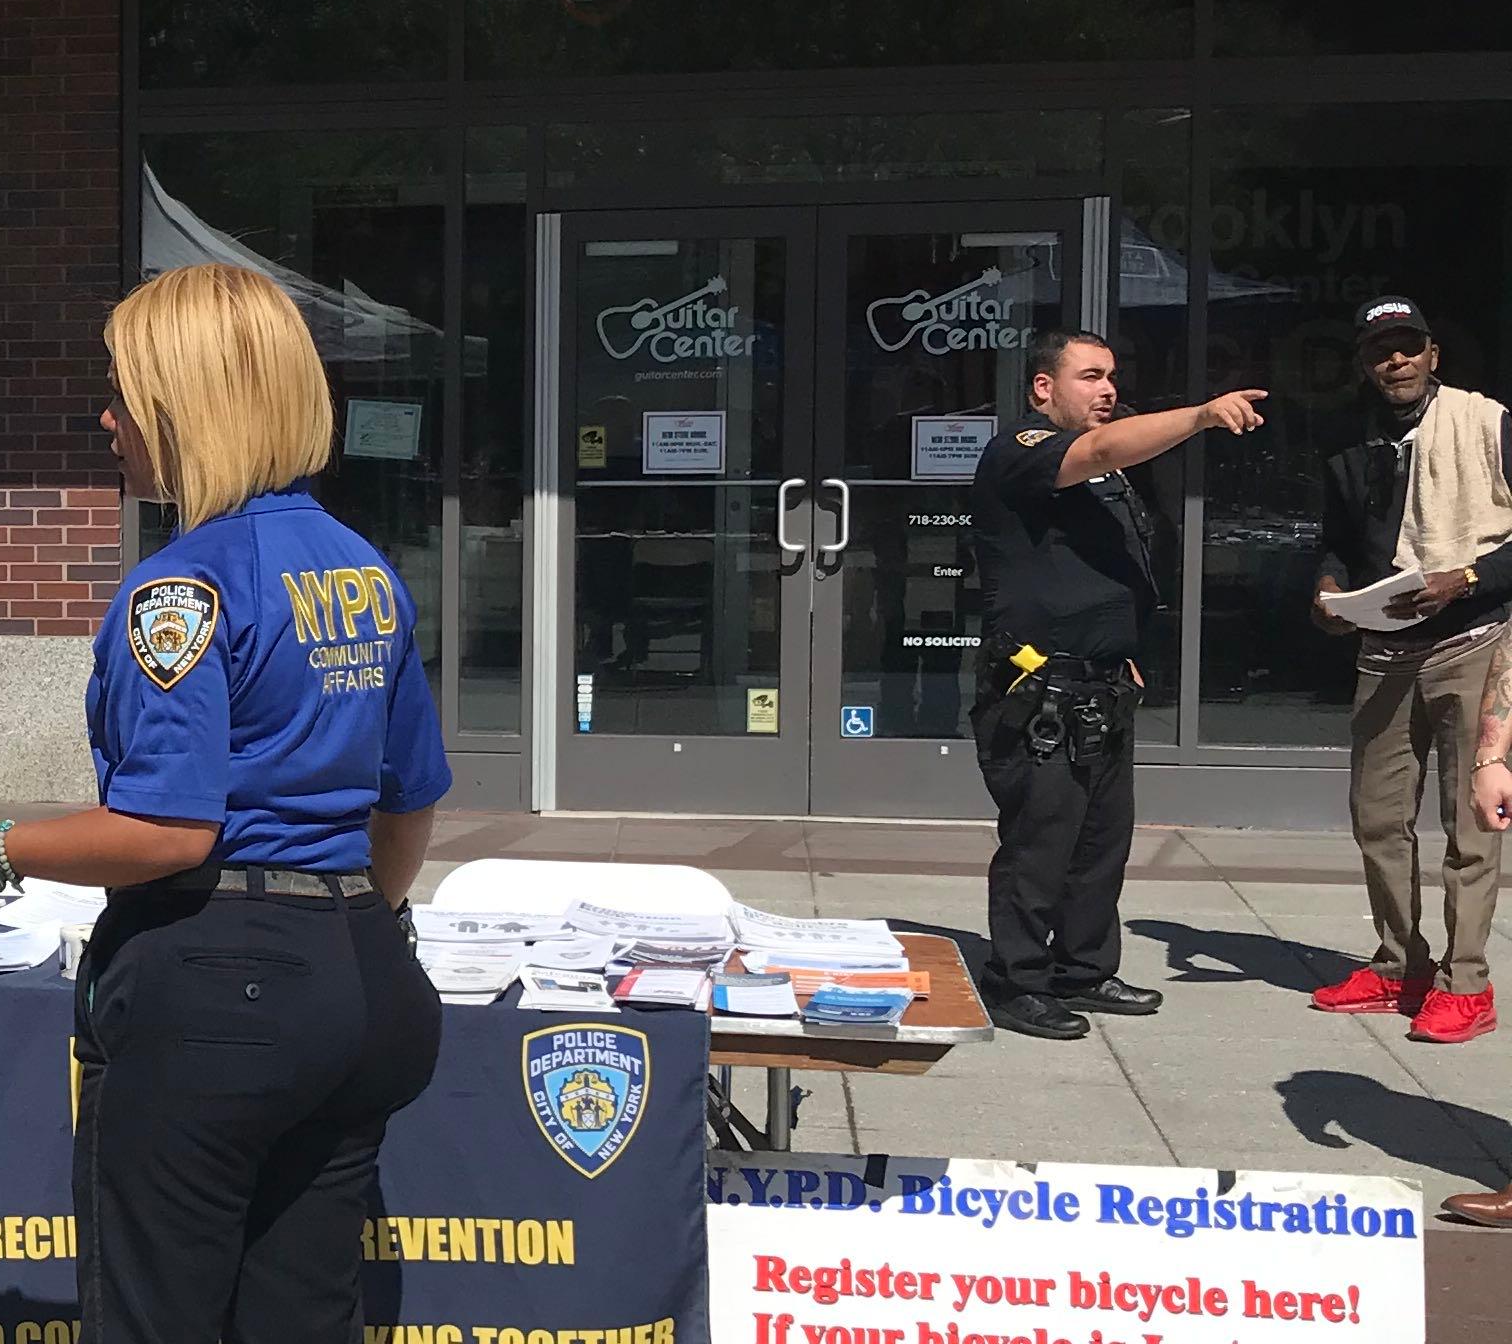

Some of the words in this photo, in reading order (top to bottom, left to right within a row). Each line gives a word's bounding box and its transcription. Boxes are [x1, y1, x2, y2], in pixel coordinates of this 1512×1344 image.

[596, 274, 738, 360] Guitar
[866, 265, 1015, 352] Guitar
[650, 328, 757, 363] Center
[922, 320, 1033, 355] Center
[635, 369, 723, 382] guitarcenter.com
[933, 567, 963, 577] Enter
[135, 596, 210, 615] DEPARTMENT
[151, 585, 195, 598] POLICE
[281, 566, 396, 644] NYPD
[133, 628, 147, 653] CITY
[144, 654, 158, 669] OF
[174, 651, 194, 674] NEW
[191, 620, 211, 650] YORK
[309, 641, 393, 669] COMMUNITY
[903, 637, 924, 646] NO
[925, 637, 981, 646] SOLICITO
[322, 666, 385, 695] AFFAIRS
[553, 1031, 617, 1051] POLICE
[530, 1048, 642, 1078] DEPARTMENT
[533, 1090, 558, 1128] CITY
[553, 1132, 575, 1151] OF
[597, 1129, 625, 1160] NEW
[620, 1084, 643, 1124] YORK
[707, 1167, 883, 1212] N.Y.P.D.
[897, 1173, 1081, 1229] Bicycle
[1095, 1183, 1418, 1239] Registration
[360, 1216, 575, 1265] REVENTION
[752, 1254, 941, 1305] Register
[950, 1273, 1056, 1312] your
[1067, 1270, 1229, 1323] bicycle
[1241, 1279, 1360, 1324] here!
